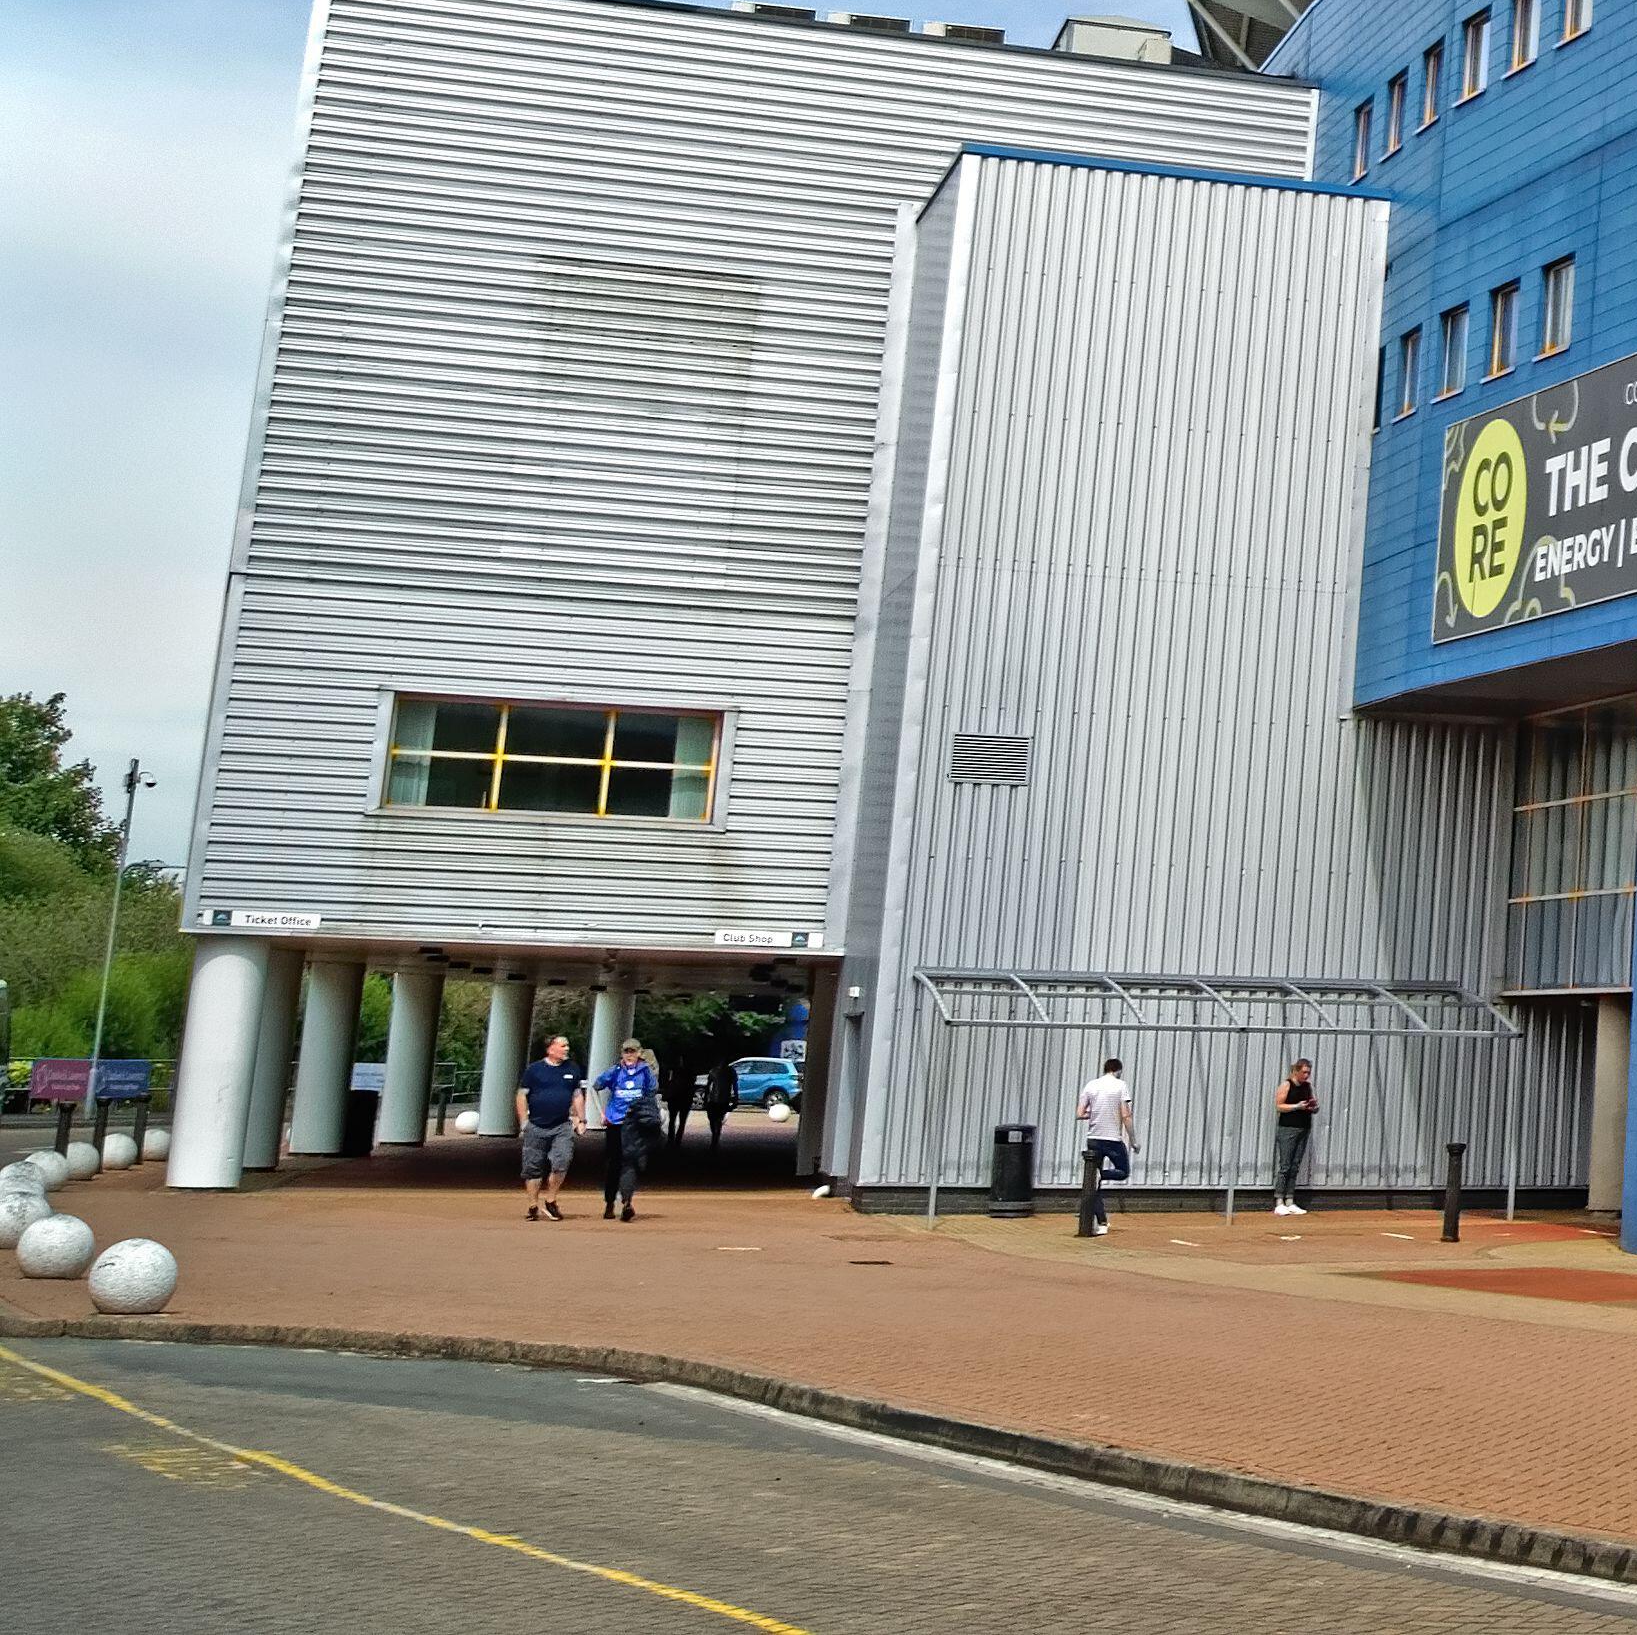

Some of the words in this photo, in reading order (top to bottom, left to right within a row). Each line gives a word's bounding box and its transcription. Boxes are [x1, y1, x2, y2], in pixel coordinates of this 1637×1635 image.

[1472, 450, 1514, 517] CO
[1545, 432, 1609, 517] THE
[1468, 516, 1509, 585] RE
[1533, 527, 1614, 583] ENERGY
[245, 914, 278, 925] Ticket
[281, 916, 312, 926] Office
[723, 933, 746, 943] Club
[749, 934, 773, 944] Shop
